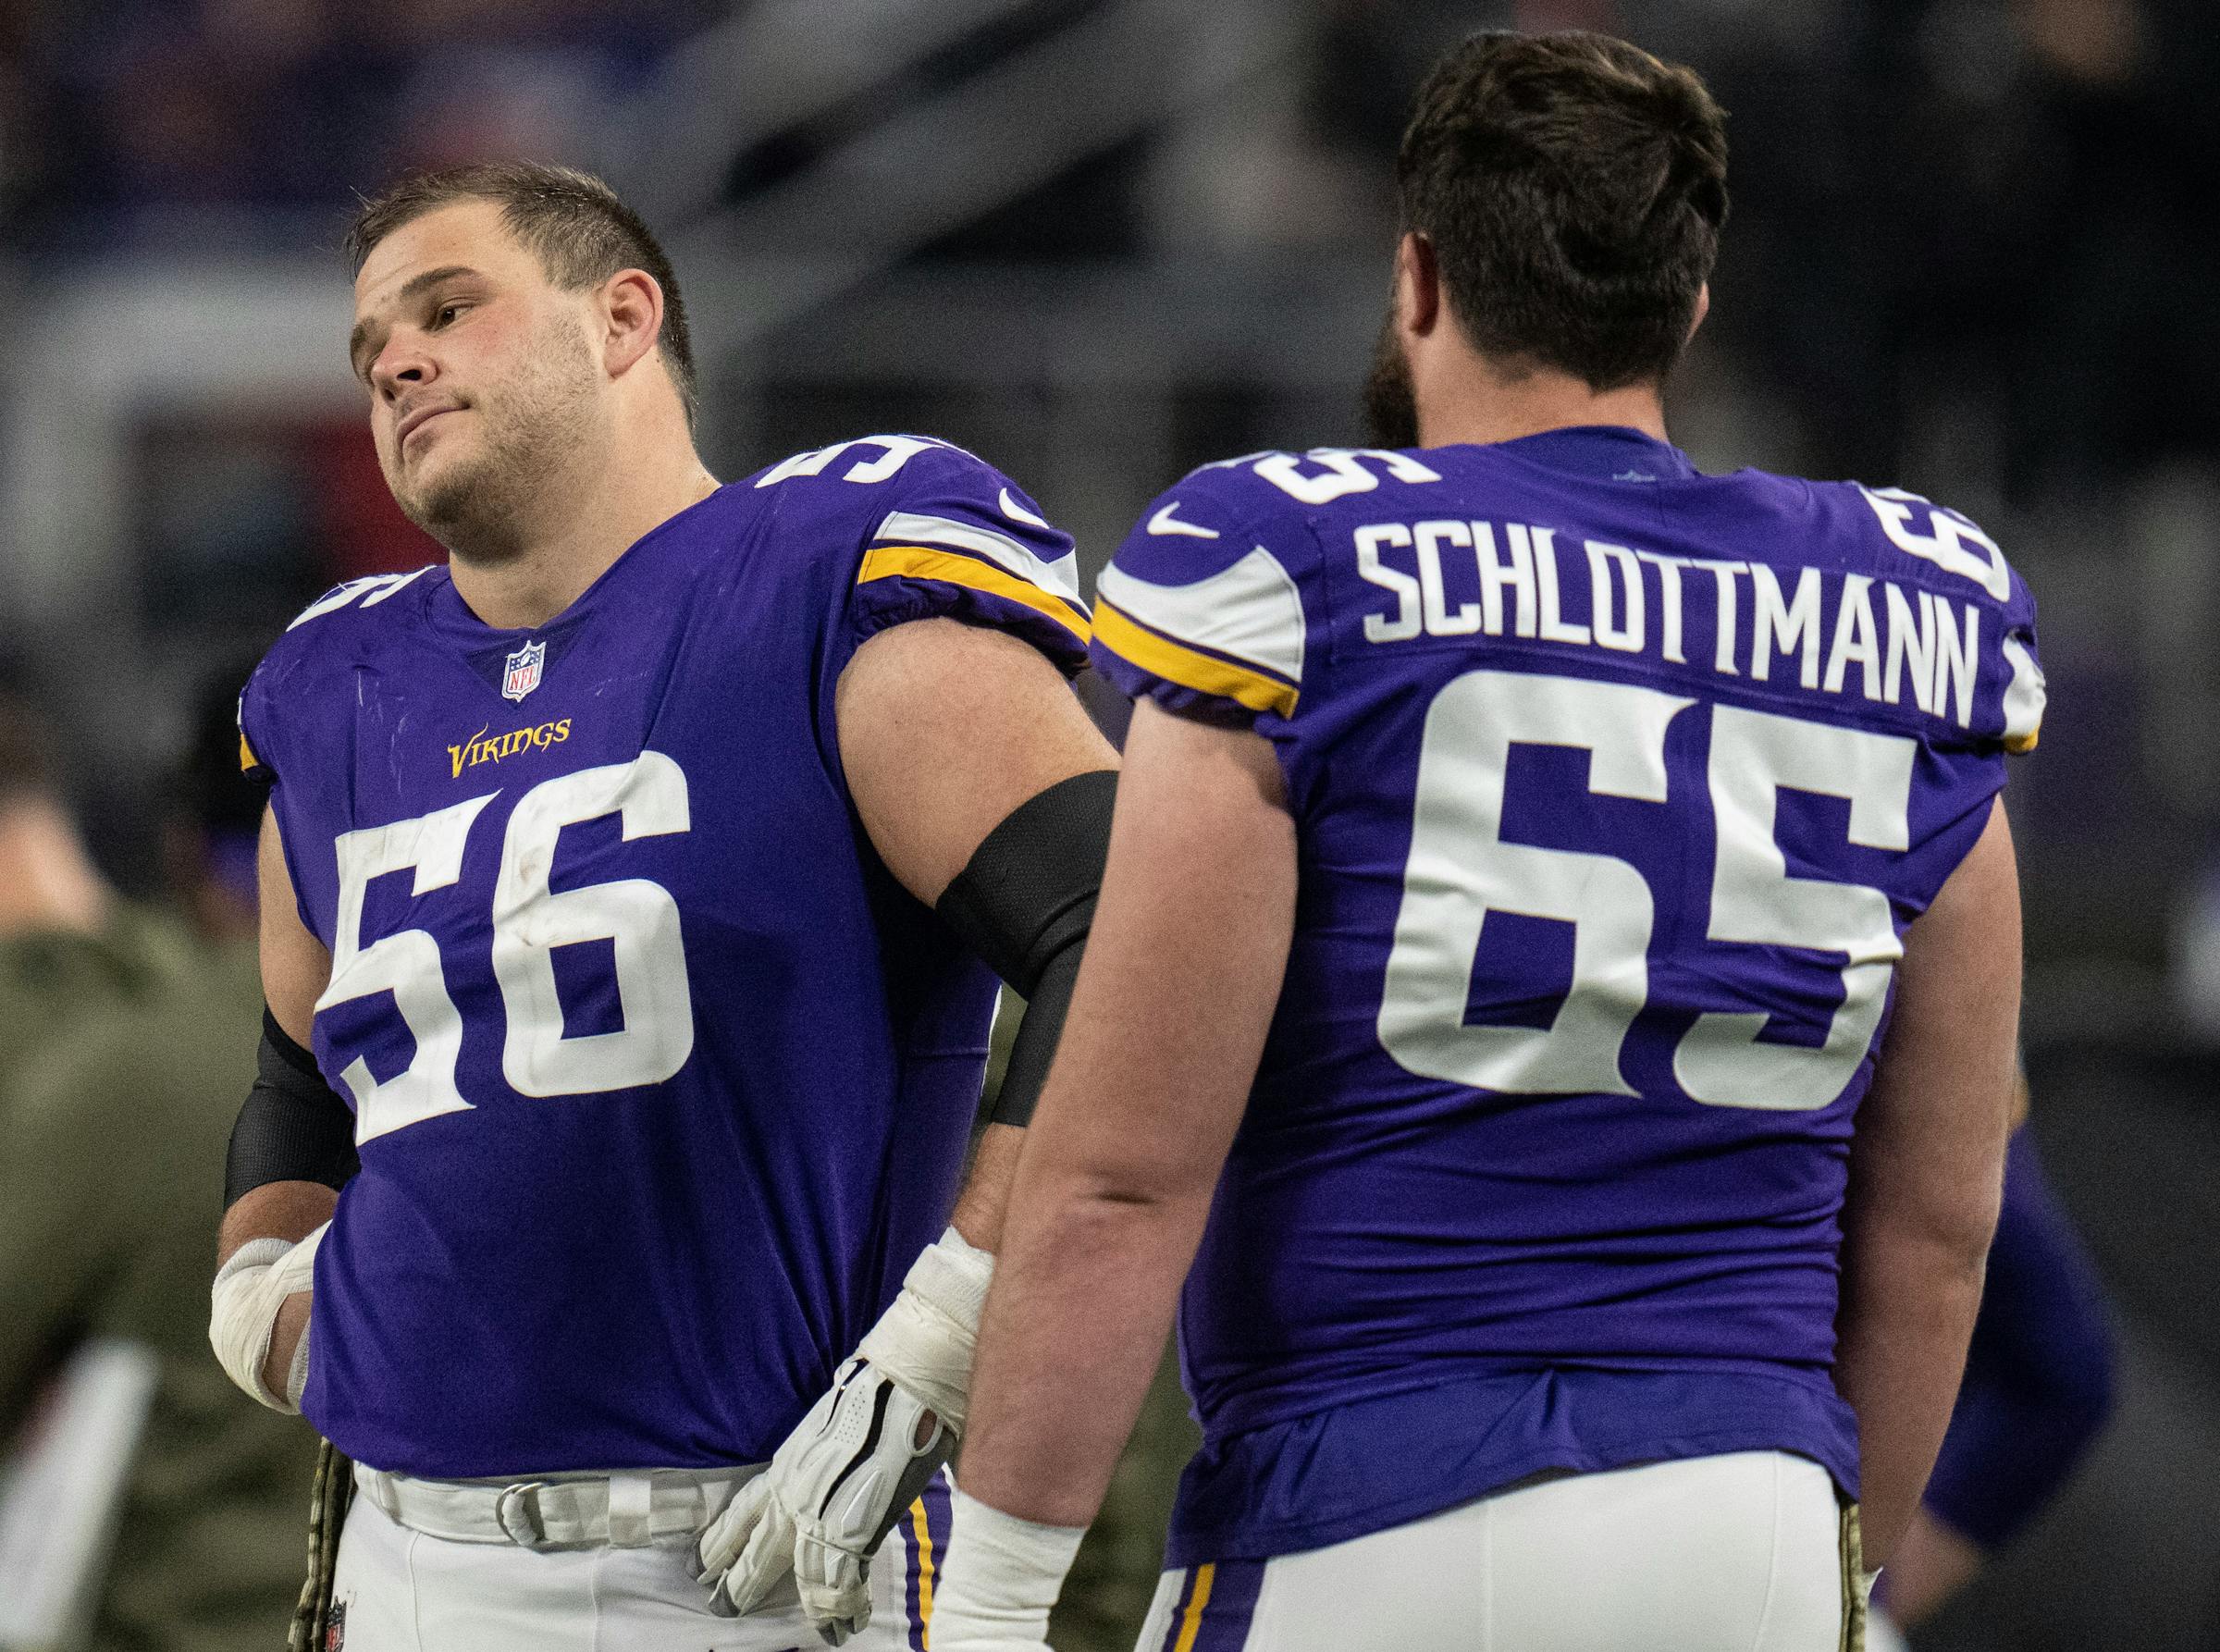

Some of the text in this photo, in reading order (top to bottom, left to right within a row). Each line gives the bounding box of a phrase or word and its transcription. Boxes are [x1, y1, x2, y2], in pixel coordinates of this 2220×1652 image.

[1189, 447, 1443, 505] 5
[1855, 481, 2011, 603] 6
[509, 665, 536, 691] NFL
[1352, 519, 1980, 729] SCHLOTTMANN
[313, 749, 696, 1147] 56
[1376, 669, 1918, 1111] 65
